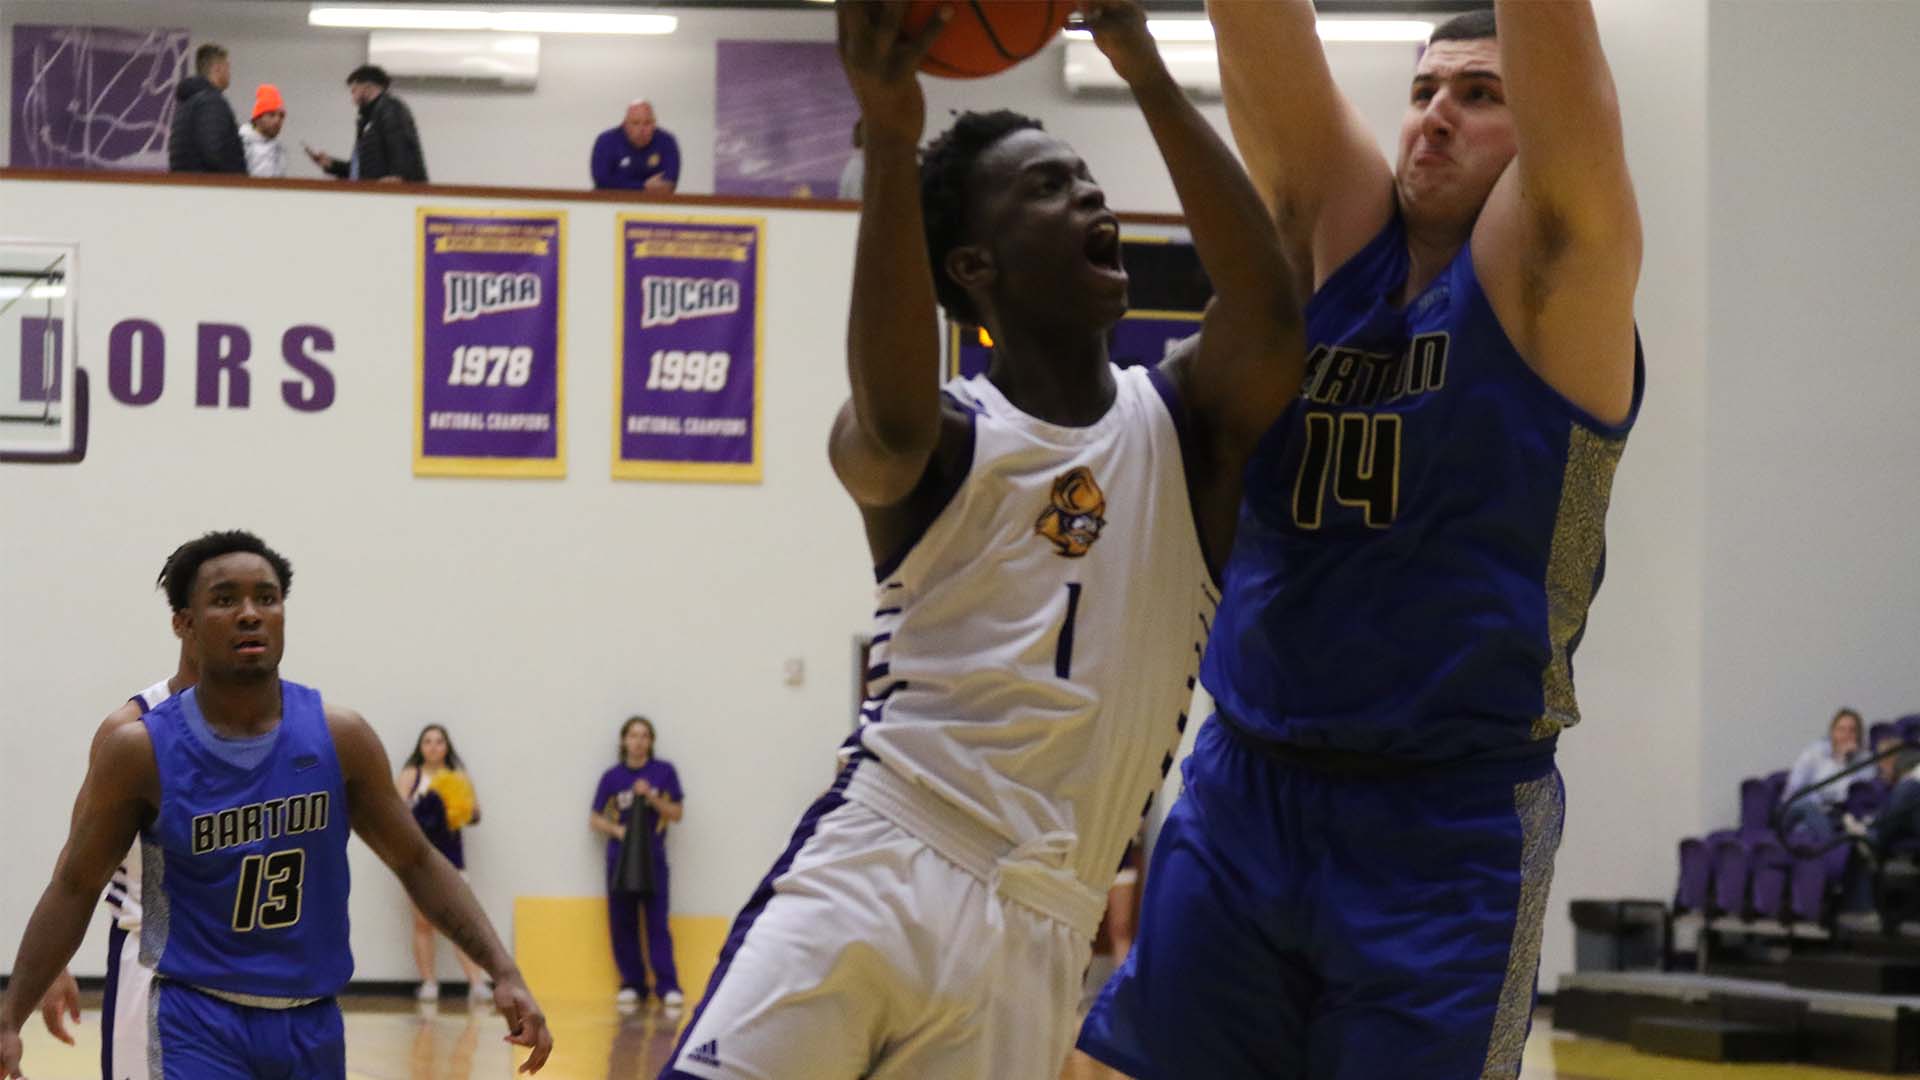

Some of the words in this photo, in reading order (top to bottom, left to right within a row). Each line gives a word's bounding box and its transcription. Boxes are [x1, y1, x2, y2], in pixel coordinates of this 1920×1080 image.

[446, 273, 538, 319] NJCAA
[644, 278, 737, 325] NJCAA
[448, 346, 534, 387] 1978
[646, 350, 731, 392] 1998
[1292, 412, 1402, 529] 14
[1055, 582, 1082, 680] 1
[192, 791, 330, 855] BARTON
[232, 848, 305, 932] 13
